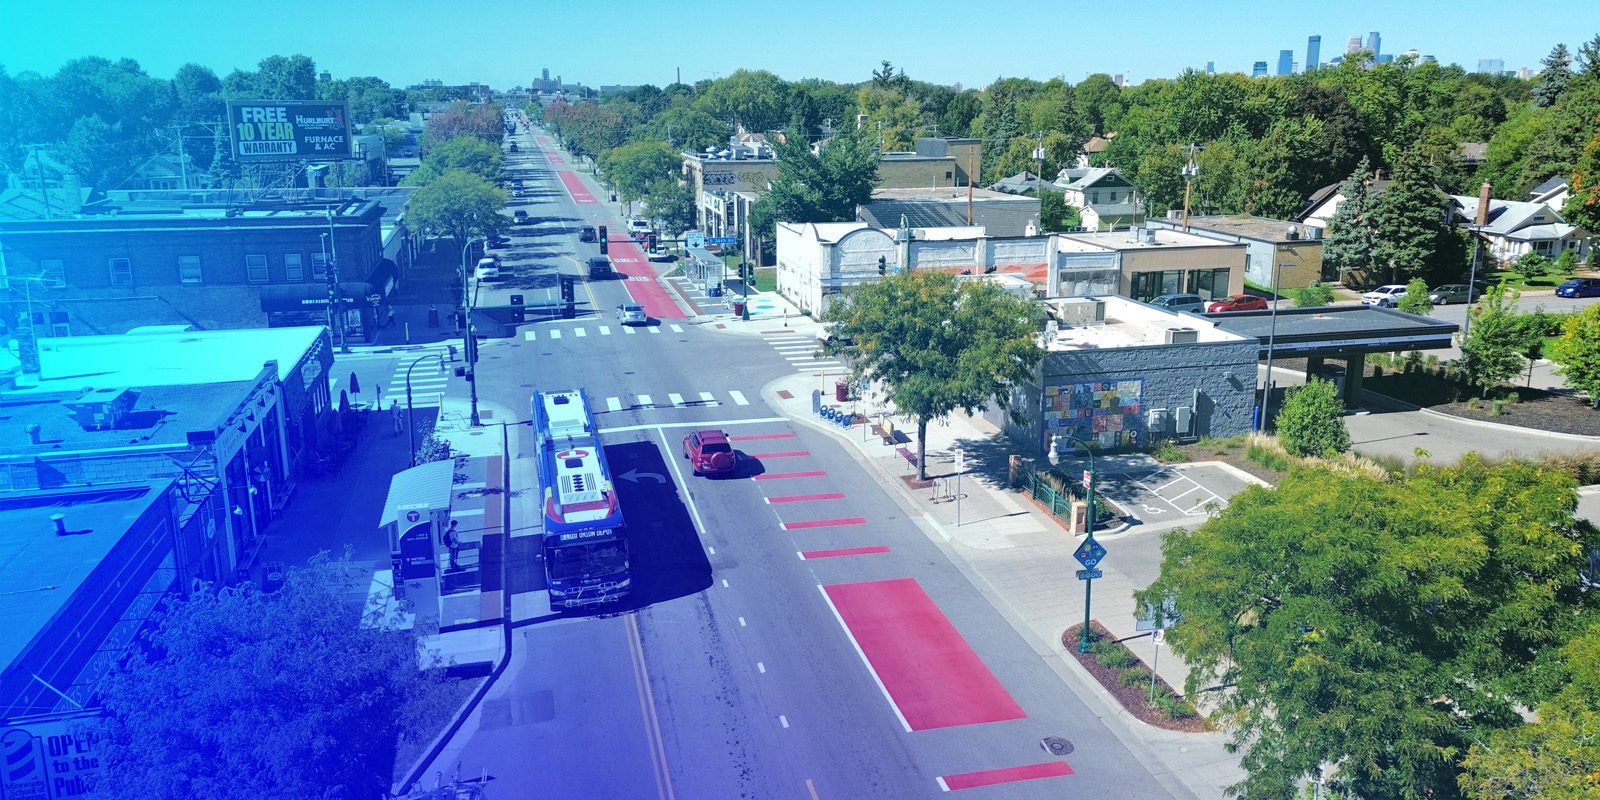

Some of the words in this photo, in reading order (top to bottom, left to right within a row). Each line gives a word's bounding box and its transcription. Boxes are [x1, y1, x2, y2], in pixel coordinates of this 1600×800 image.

[241, 107, 288, 122] FREE
[295, 115, 335, 124] HURLBURT
[236, 122, 256, 141] 10
[257, 123, 294, 141] YEAR
[304, 135, 344, 143] FURNACE
[242, 142, 293, 154] WARRANTY
[314, 143, 322, 151] &
[578, 530, 596, 538] UNION
[596, 528, 612, 537] DEPOT
[1085, 558, 1097, 566] GO
[52, 759, 70, 773] to
[72, 756, 99, 771] the
